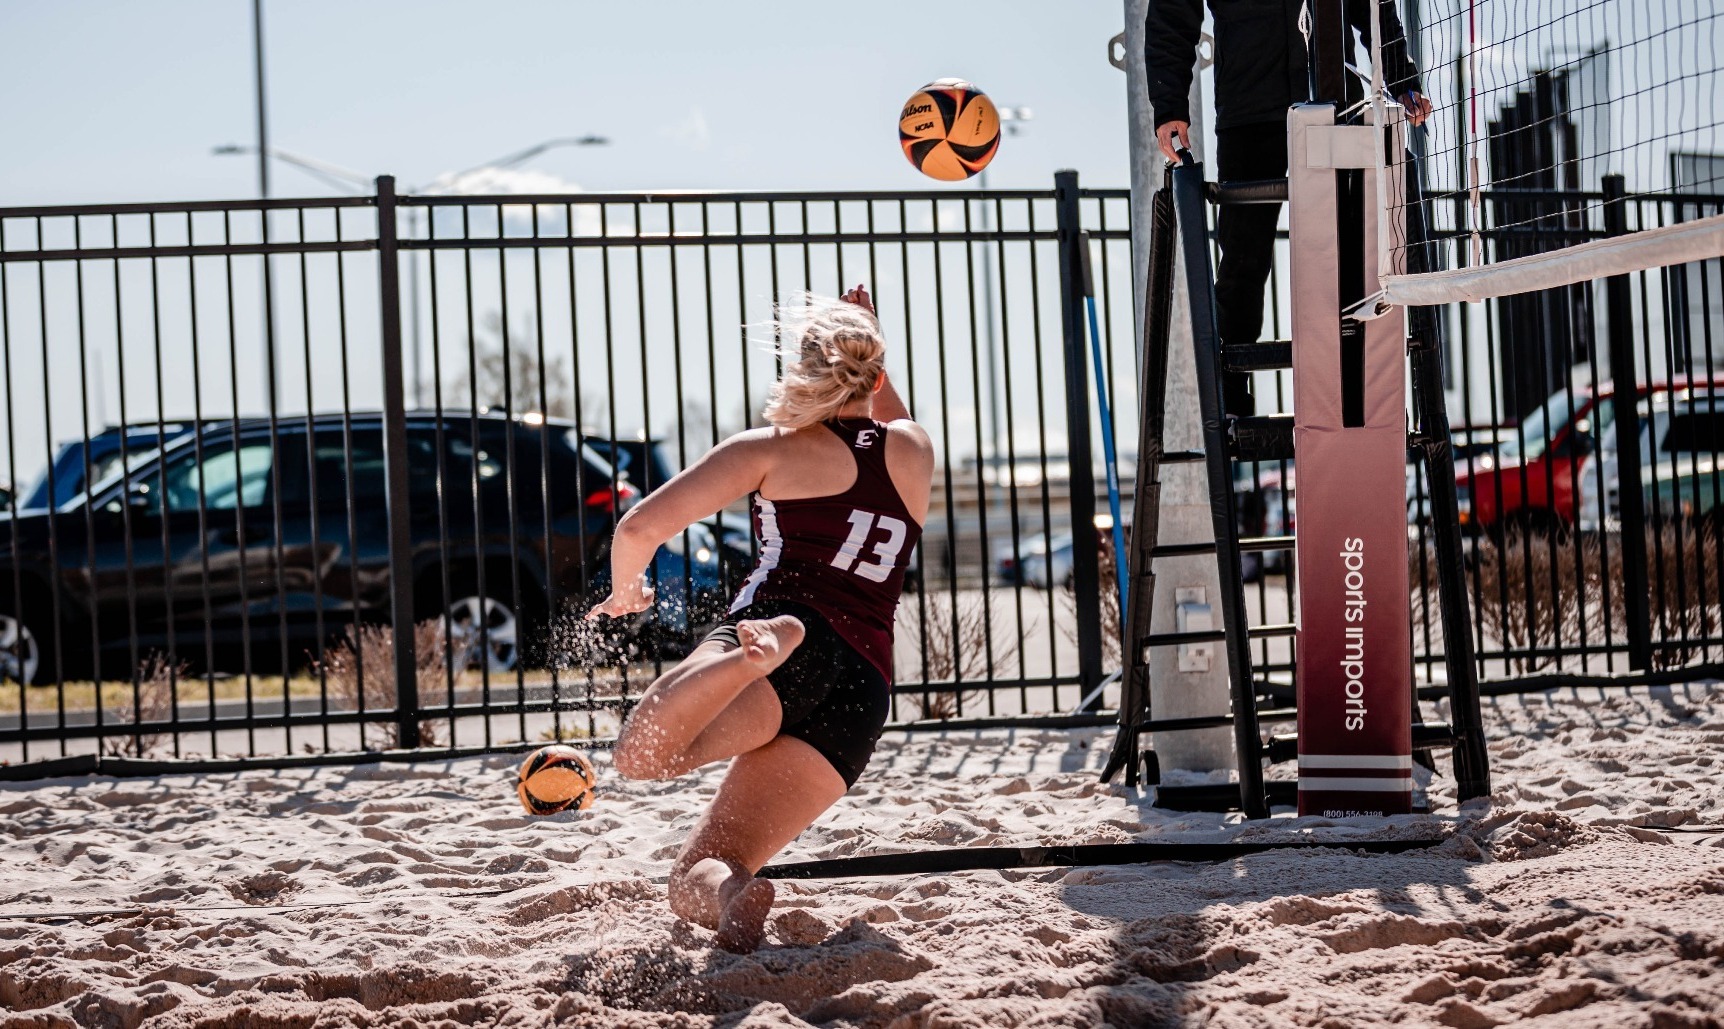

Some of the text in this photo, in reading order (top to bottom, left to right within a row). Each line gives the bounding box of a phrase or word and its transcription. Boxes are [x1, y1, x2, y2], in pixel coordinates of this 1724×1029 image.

[914, 121, 934, 132] NCAA
[855, 429, 878, 449] E
[830, 509, 907, 583] 13
[1340, 537, 1367, 731] sports imports
[1323, 809, 1344, 818] (800)
